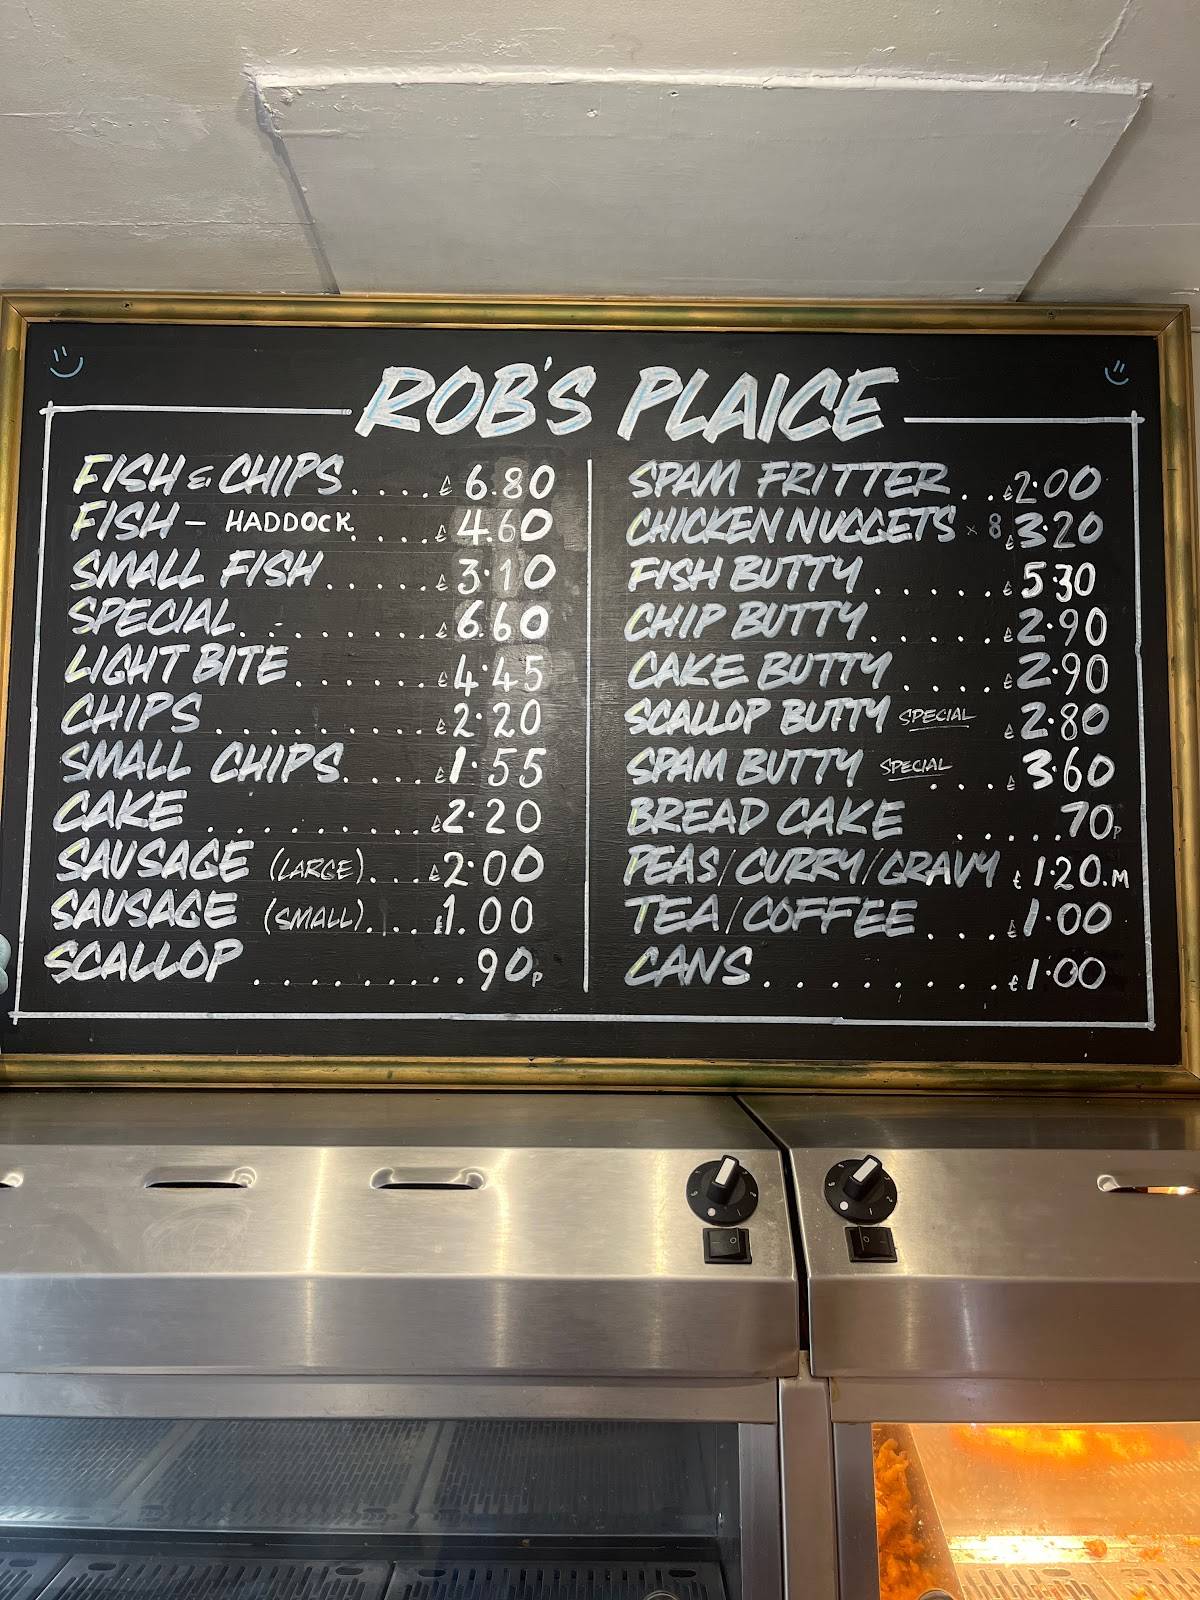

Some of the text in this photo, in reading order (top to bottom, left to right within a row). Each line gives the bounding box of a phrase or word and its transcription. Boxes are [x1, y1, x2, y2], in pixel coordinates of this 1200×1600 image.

[354, 357, 900, 443] ROB'S PLAICE
[73, 453, 186, 496] FISH
[219, 452, 344, 497] CHIPS
[628, 460, 741, 499] SPAM
[757, 461, 951, 497] FRITTER
[70, 500, 180, 541] FISH
[225, 509, 354, 532] HADDOCK
[625, 506, 784, 545] CHICKEN
[787, 505, 956, 544] NUGGETS
[989, 512, 1002, 539] 8
[70, 548, 204, 591] SMALL
[219, 550, 324, 588] FISH
[628, 557, 723, 594] FISH
[729, 555, 862, 594] BUTTY
[67, 597, 235, 635] SPECIAL
[624, 603, 726, 641] CHIP
[731, 601, 867, 640] BUTTY
[65, 644, 189, 685] LIGHT
[193, 644, 288, 684] BITE
[627, 651, 748, 690] CAKE
[756, 651, 892, 690] BUTTY
[61, 693, 201, 735] CHIPS
[625, 698, 769, 737] SCALLOP
[780, 695, 891, 736] BUTTY
[899, 707, 976, 726] SPECIAL
[61, 740, 191, 783] SMALL
[210, 741, 344, 785] CHIPS
[626, 747, 726, 786] SPAM
[736, 747, 863, 787] BUTTY
[880, 758, 953, 775] SPECIAL
[53, 789, 187, 833] CAKE
[627, 797, 769, 836] BREAD
[776, 798, 905, 839] CAKE
[56, 839, 254, 882] SAUSAGE
[269, 847, 364, 884] (LARGE)
[50, 888, 237, 931] SAUSAGE
[264, 899, 364, 935] (SMALL)
[43, 938, 244, 984] SCALLOP
[623, 945, 752, 987] CANS
